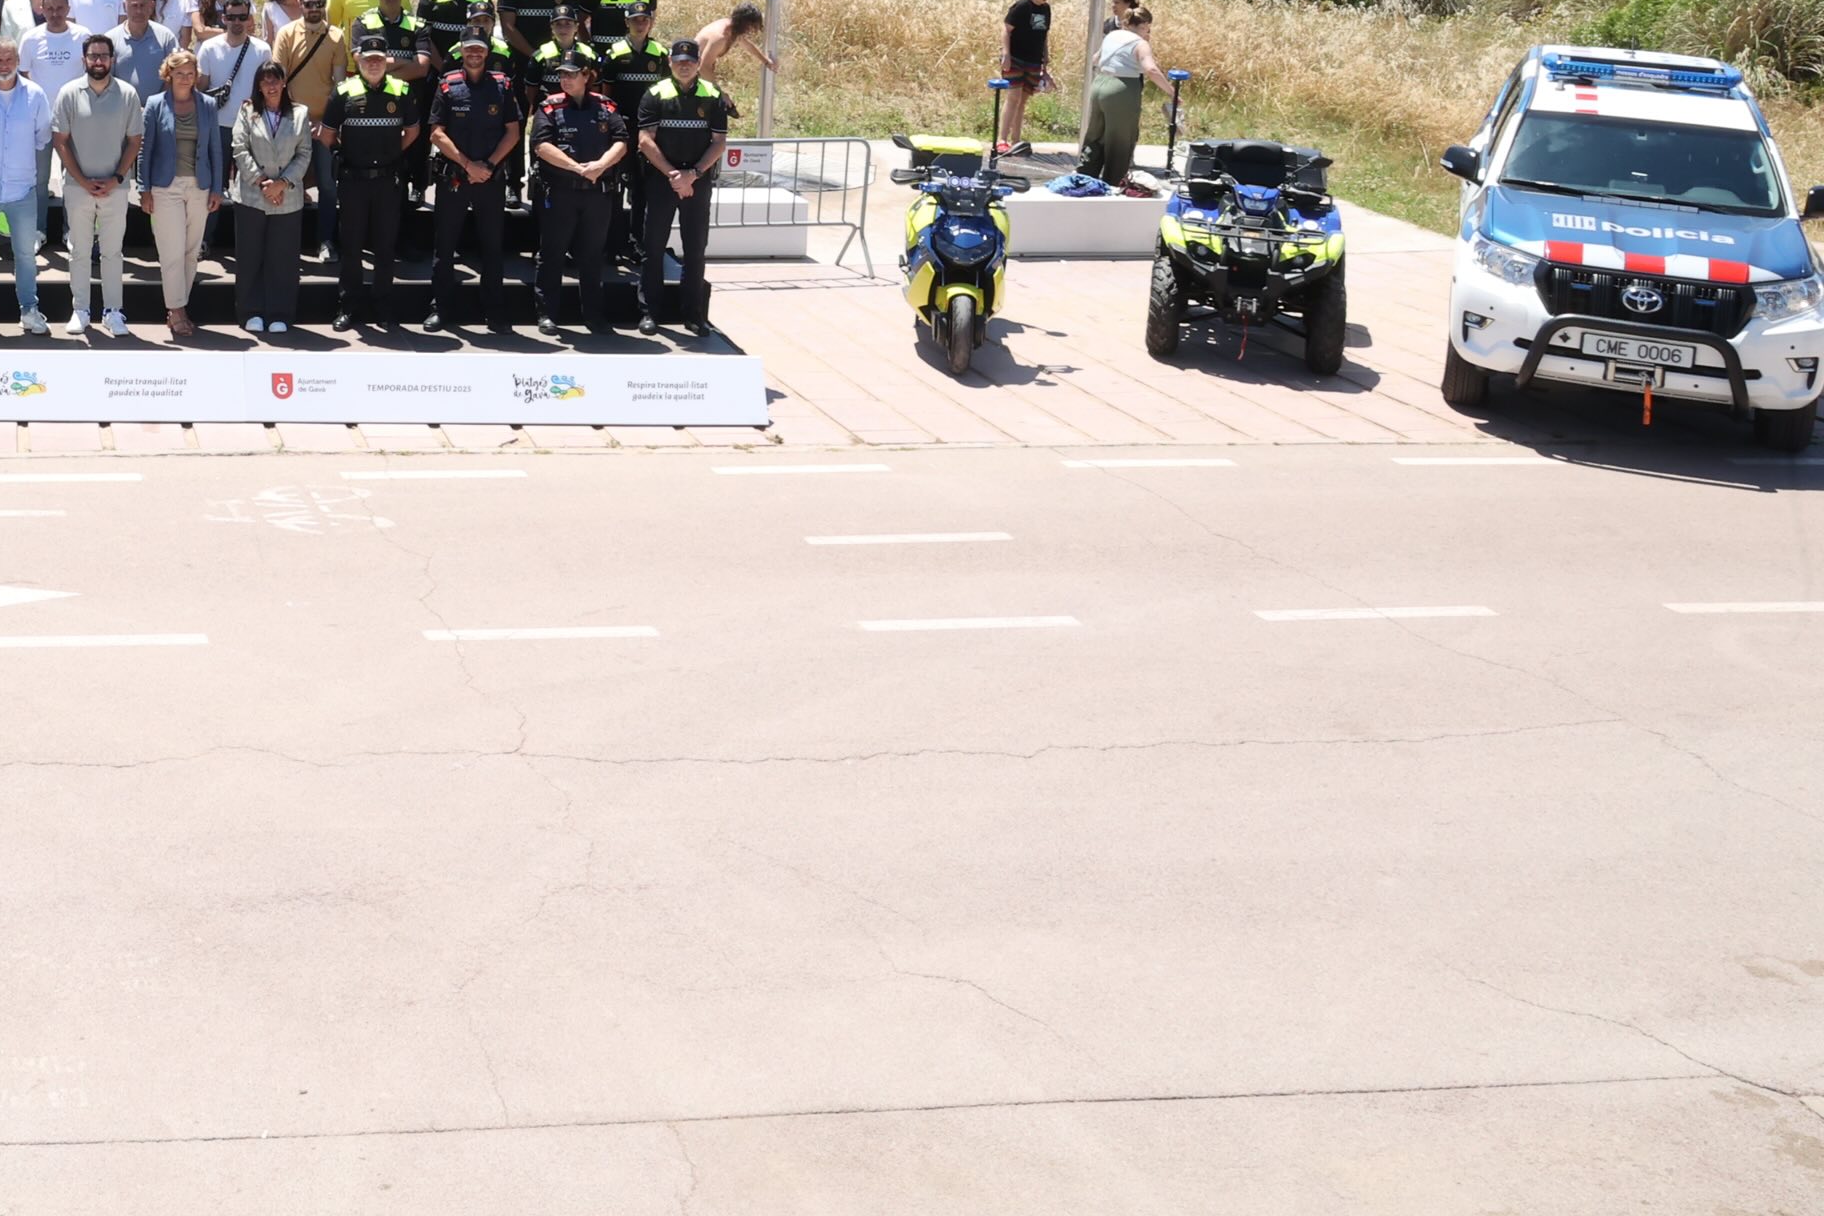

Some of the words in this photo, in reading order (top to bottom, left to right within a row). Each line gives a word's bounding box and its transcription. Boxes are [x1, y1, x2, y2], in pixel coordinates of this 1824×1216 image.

[1601, 221, 1736, 245] policia
[1596, 337, 1628, 356] CME
[1637, 343, 1683, 364] 0006
[104, 377, 134, 387] Respira
[297, 378, 337, 387] Ajuntament
[627, 381, 656, 391] Respira
[108, 388, 140, 398] gaudeix
[141, 388, 150, 397] la
[150, 388, 183, 398] qualitat
[367, 384, 420, 392] TEMPORADA
[420, 384, 452, 392] D'ESTIU
[453, 385, 472, 393] 2025
[631, 392, 664, 402] gaudeix
[664, 392, 672, 401] la
[673, 392, 706, 402] qualitat
